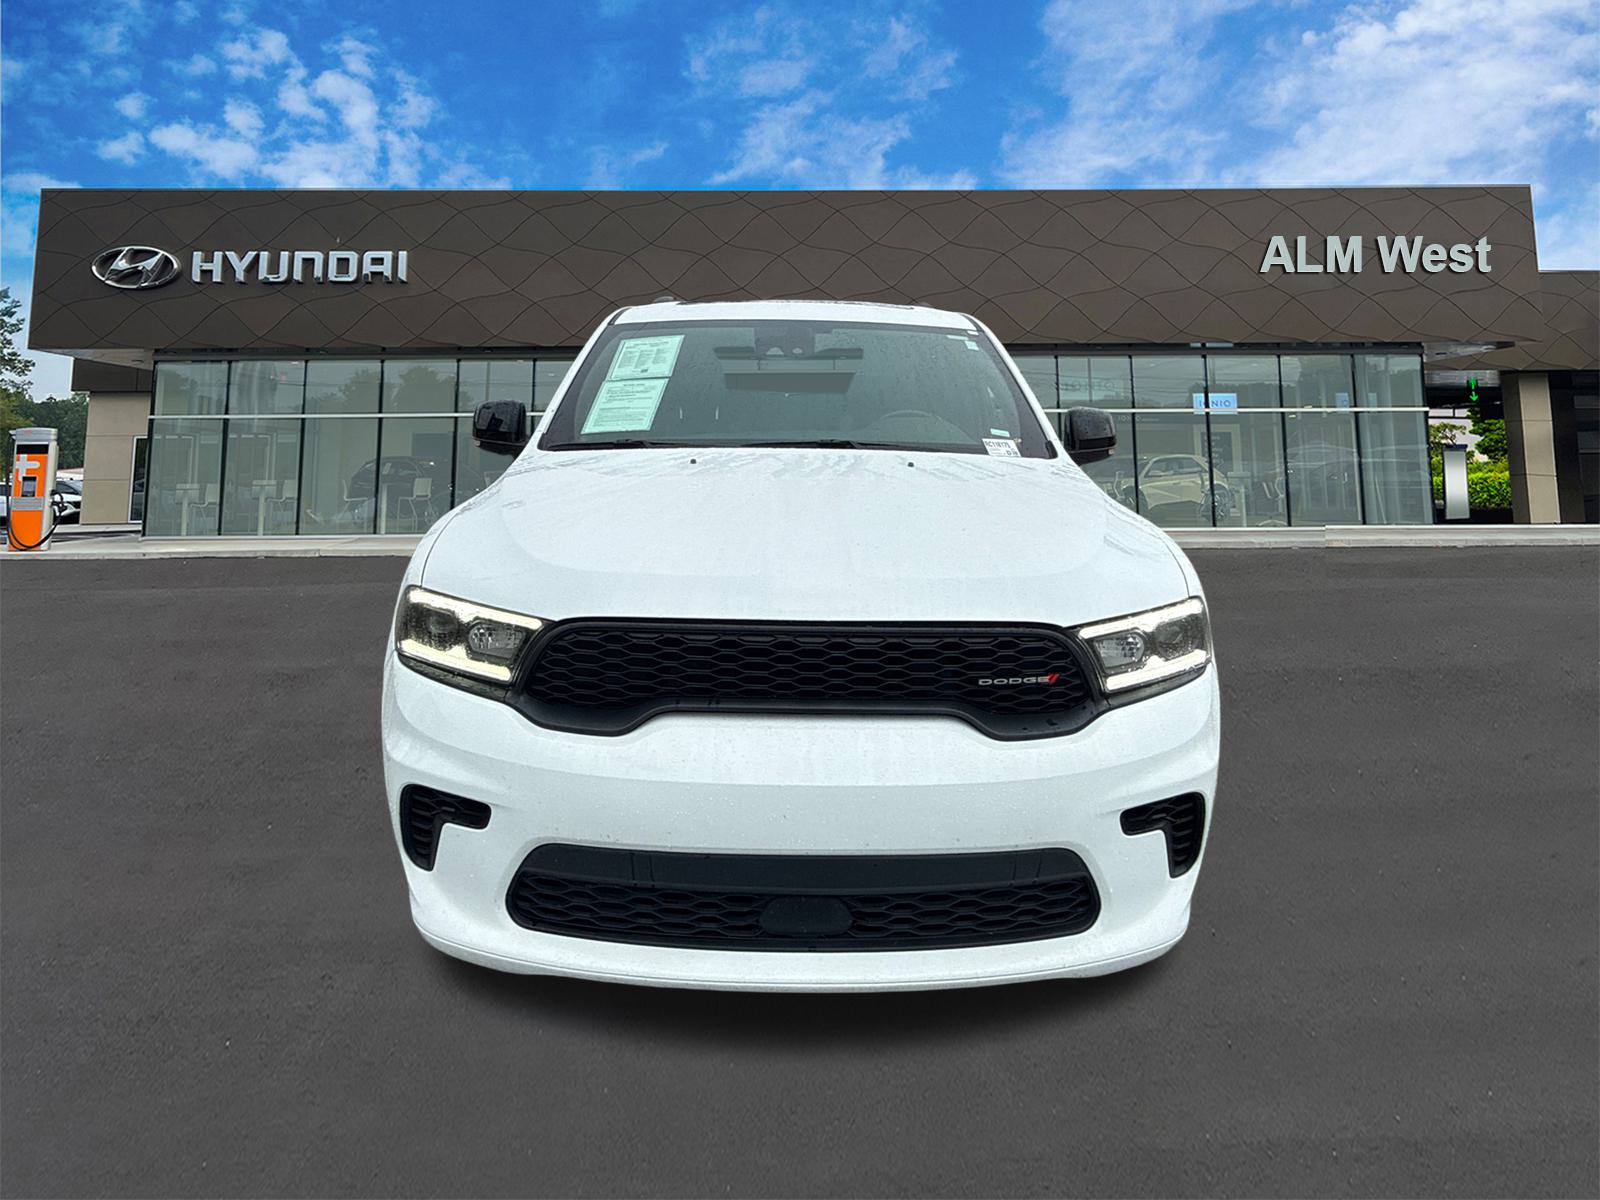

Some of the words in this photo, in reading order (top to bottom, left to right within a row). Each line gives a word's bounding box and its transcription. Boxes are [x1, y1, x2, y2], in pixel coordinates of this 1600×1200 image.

[192, 251, 408, 283] HYUNDAI
[1260, 236, 1363, 273] ALM
[1377, 236, 1492, 273] West
[979, 676, 1049, 685] DODGE
